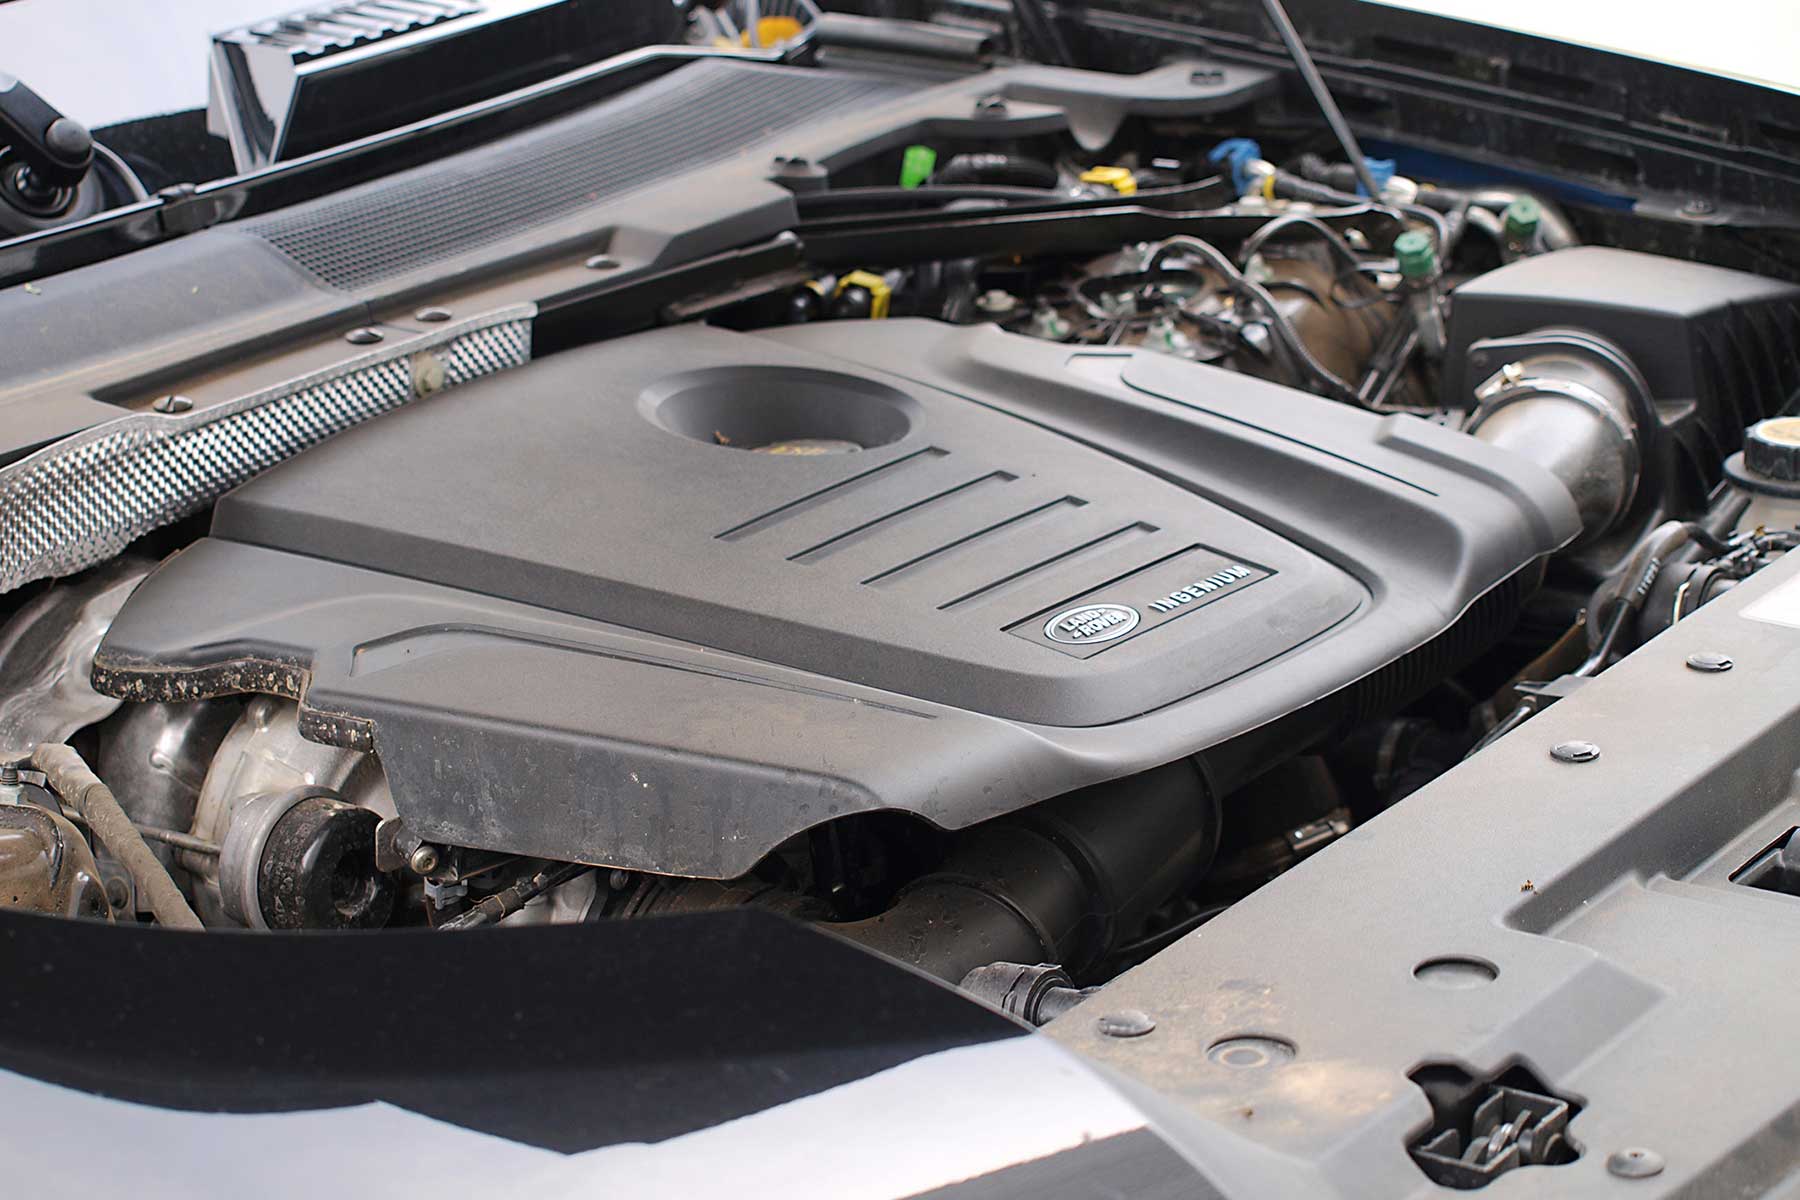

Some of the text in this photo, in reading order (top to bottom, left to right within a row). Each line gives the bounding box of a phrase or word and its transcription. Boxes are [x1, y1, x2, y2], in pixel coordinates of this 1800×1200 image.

[1148, 565, 1251, 613] INGENIUM
[1059, 610, 1102, 632] LAND
[1078, 612, 1127, 637] ROVER
